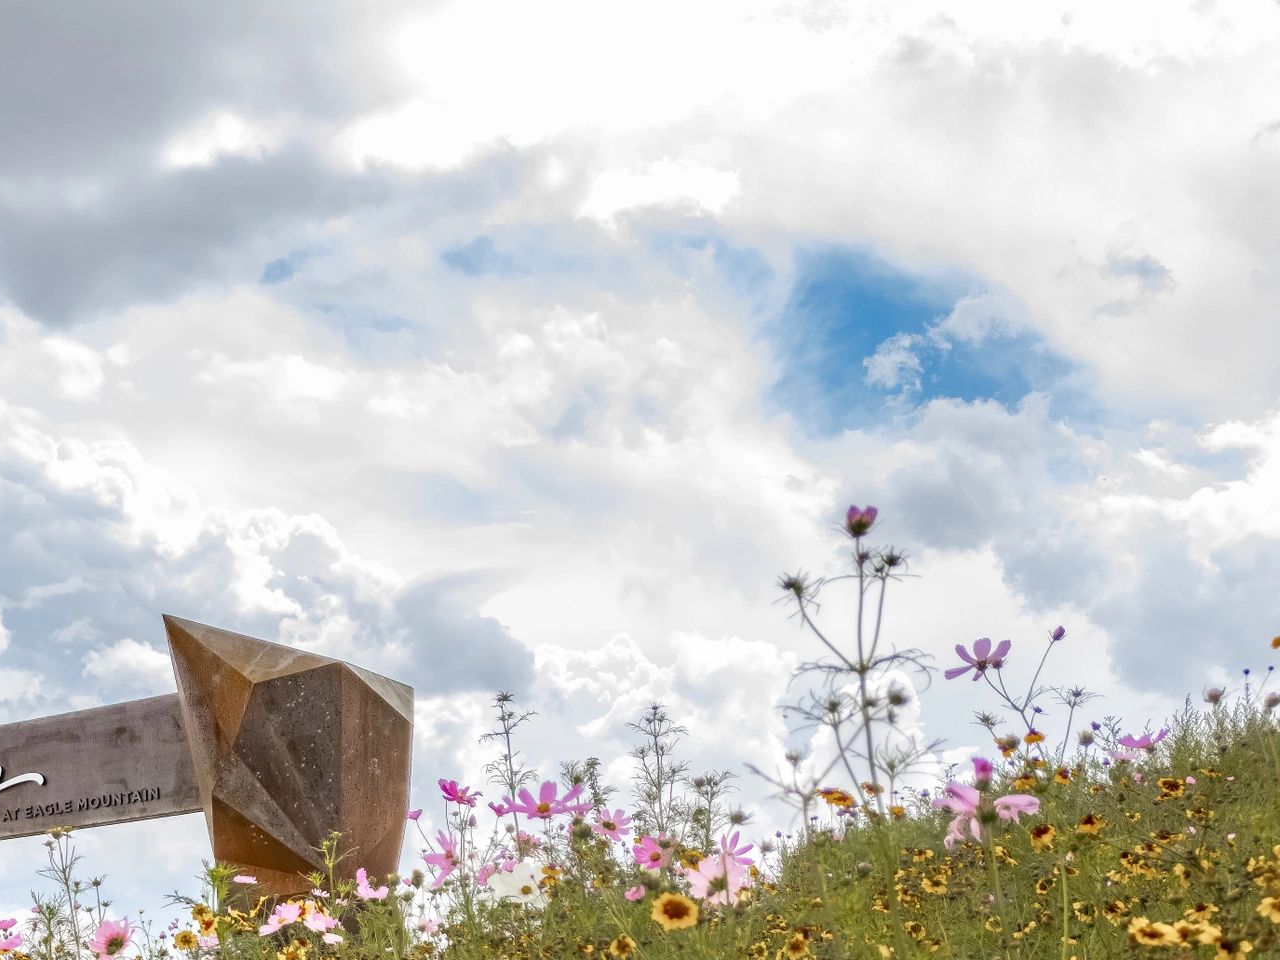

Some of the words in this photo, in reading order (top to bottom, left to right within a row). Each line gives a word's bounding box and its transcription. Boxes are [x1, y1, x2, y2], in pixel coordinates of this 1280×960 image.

[2, 808, 20, 822] AT
[25, 801, 73, 819] EAGLE
[78, 787, 161, 811] MOUNTAIN
